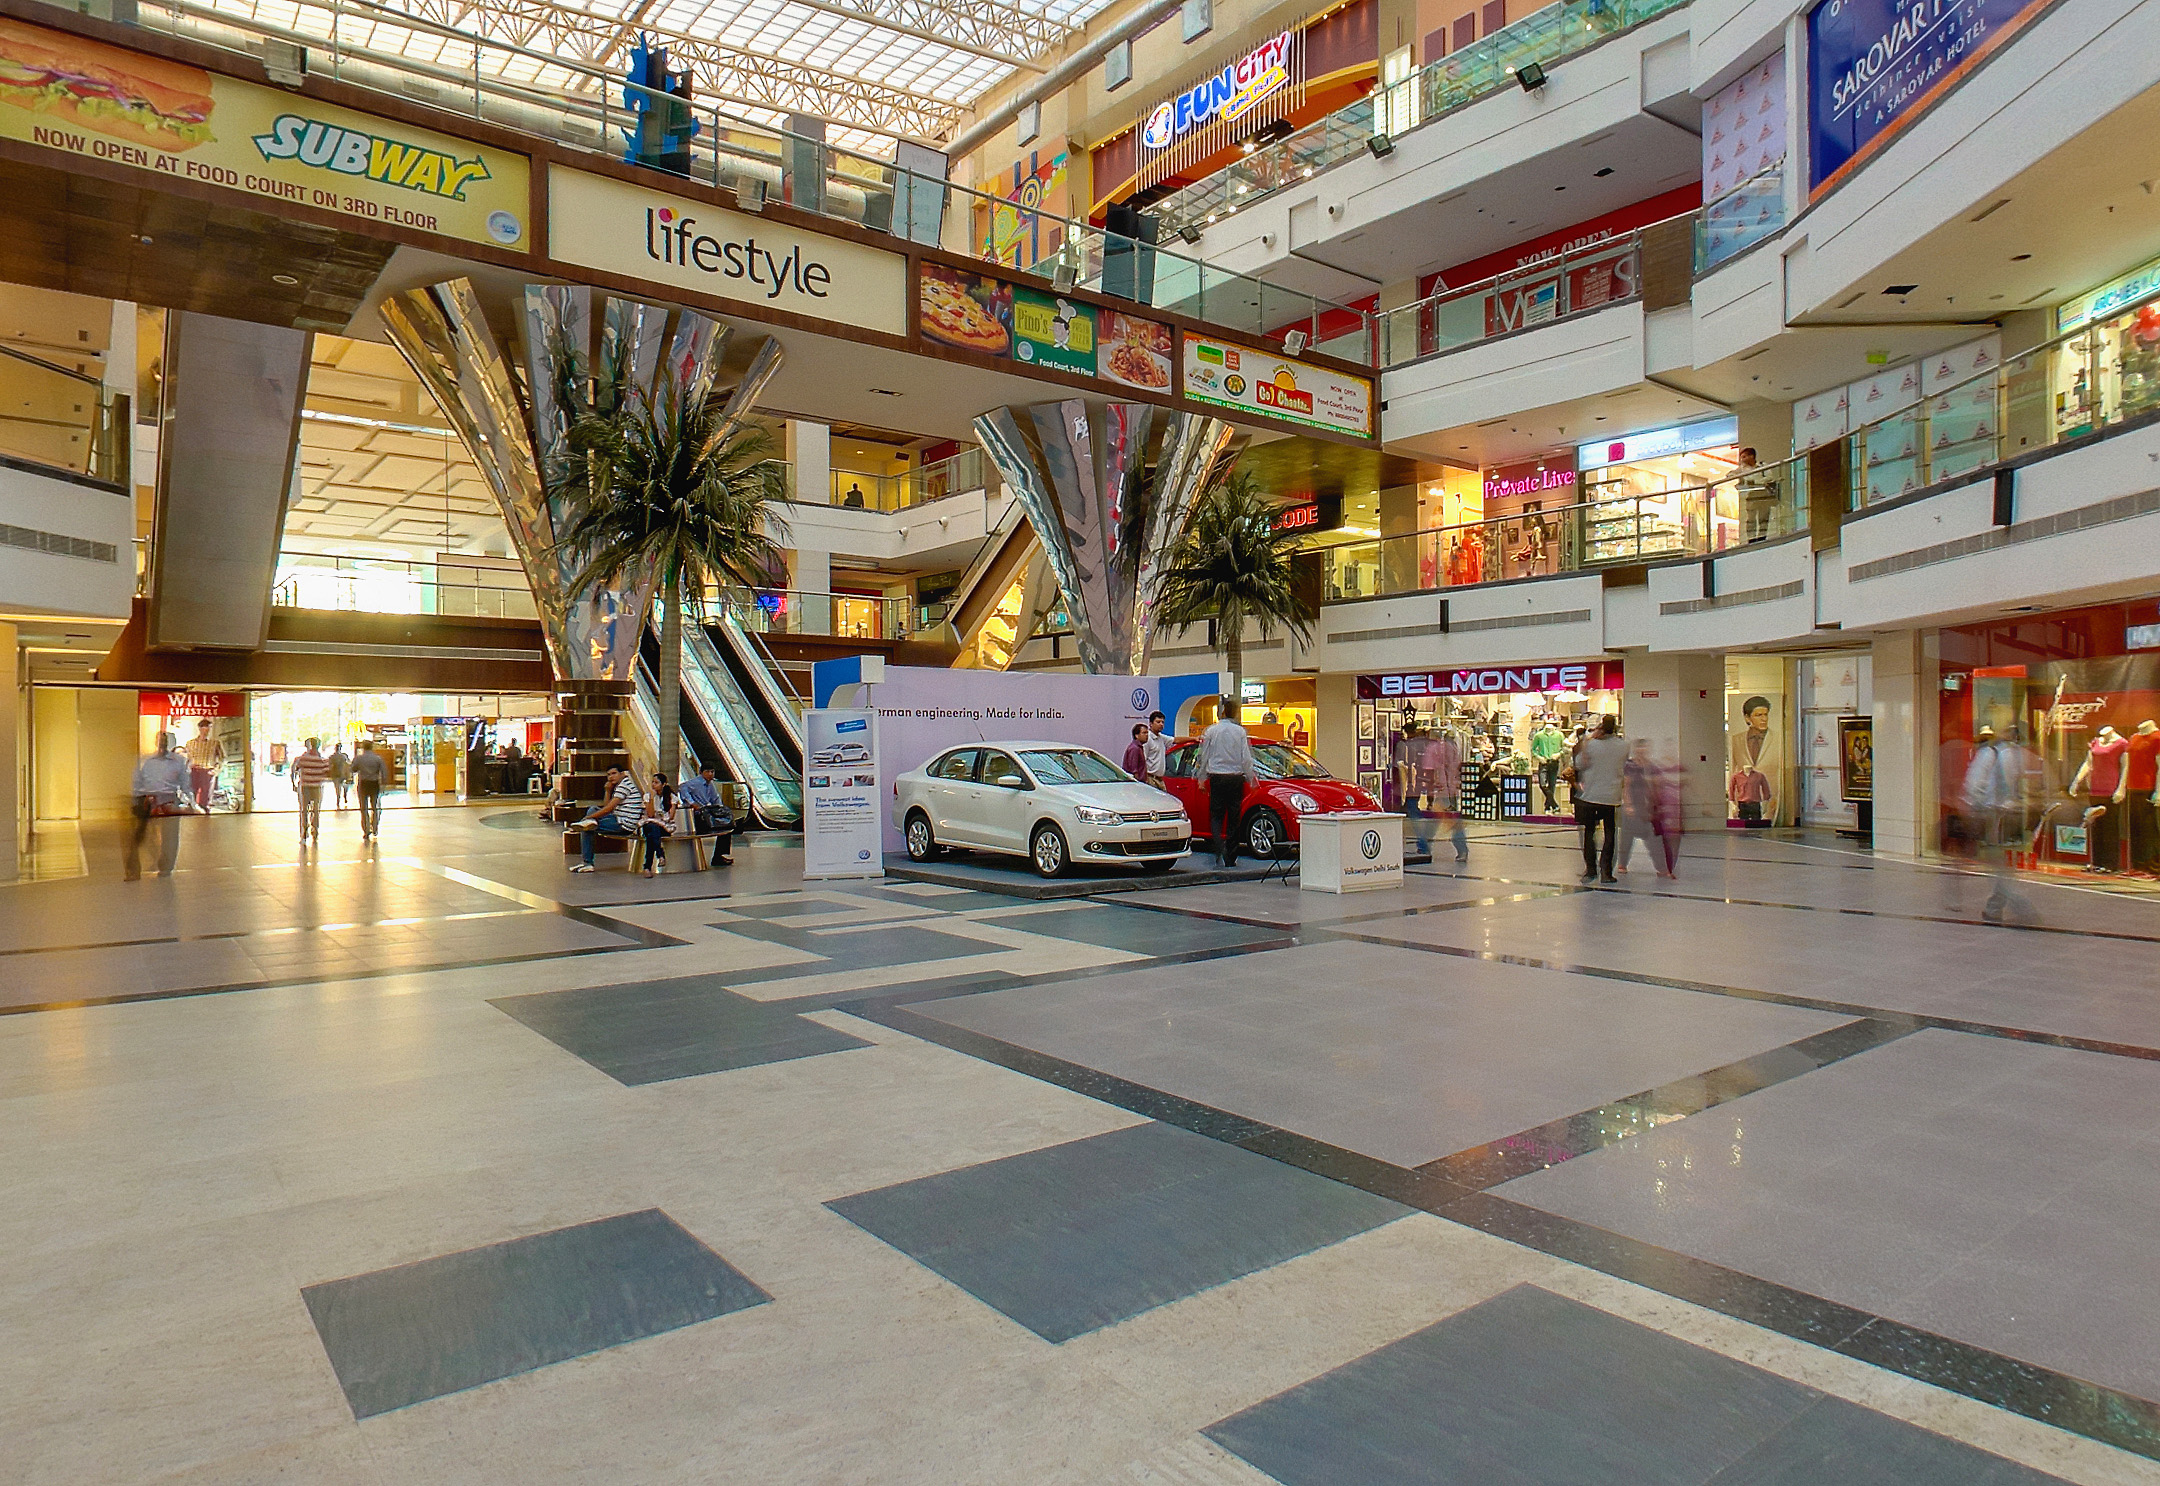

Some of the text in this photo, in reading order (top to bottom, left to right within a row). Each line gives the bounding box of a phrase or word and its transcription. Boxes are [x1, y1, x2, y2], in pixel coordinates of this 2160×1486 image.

[1832, 2, 1927, 111] SAROVAR
[1876, 18, 1986, 124] A SAROVAR HOTEL
[1176, 67, 1232, 131] FUN
[251, 114, 492, 201] SUBWAY
[33, 126, 438, 231] NOW OPEN AT FOOD COURT ON 3RD FLOOR
[645, 206, 831, 299] lifestyle
[1516, 228, 1613, 268] NOW OPEN
[1017, 308, 1048, 335] Pino's
[1039, 358, 1053, 368] Food
[1081, 367, 1095, 377] Floor
[1381, 666, 1587, 695] BELMONTE
[168, 694, 220, 708] WILLS
[170, 708, 218, 716] LIFESTYLE
[879, 706, 1065, 720] rman engineering. Made for India.
[1343, 866, 1373, 876] Volkswagen
[1374, 864, 1386, 873] Delhi
